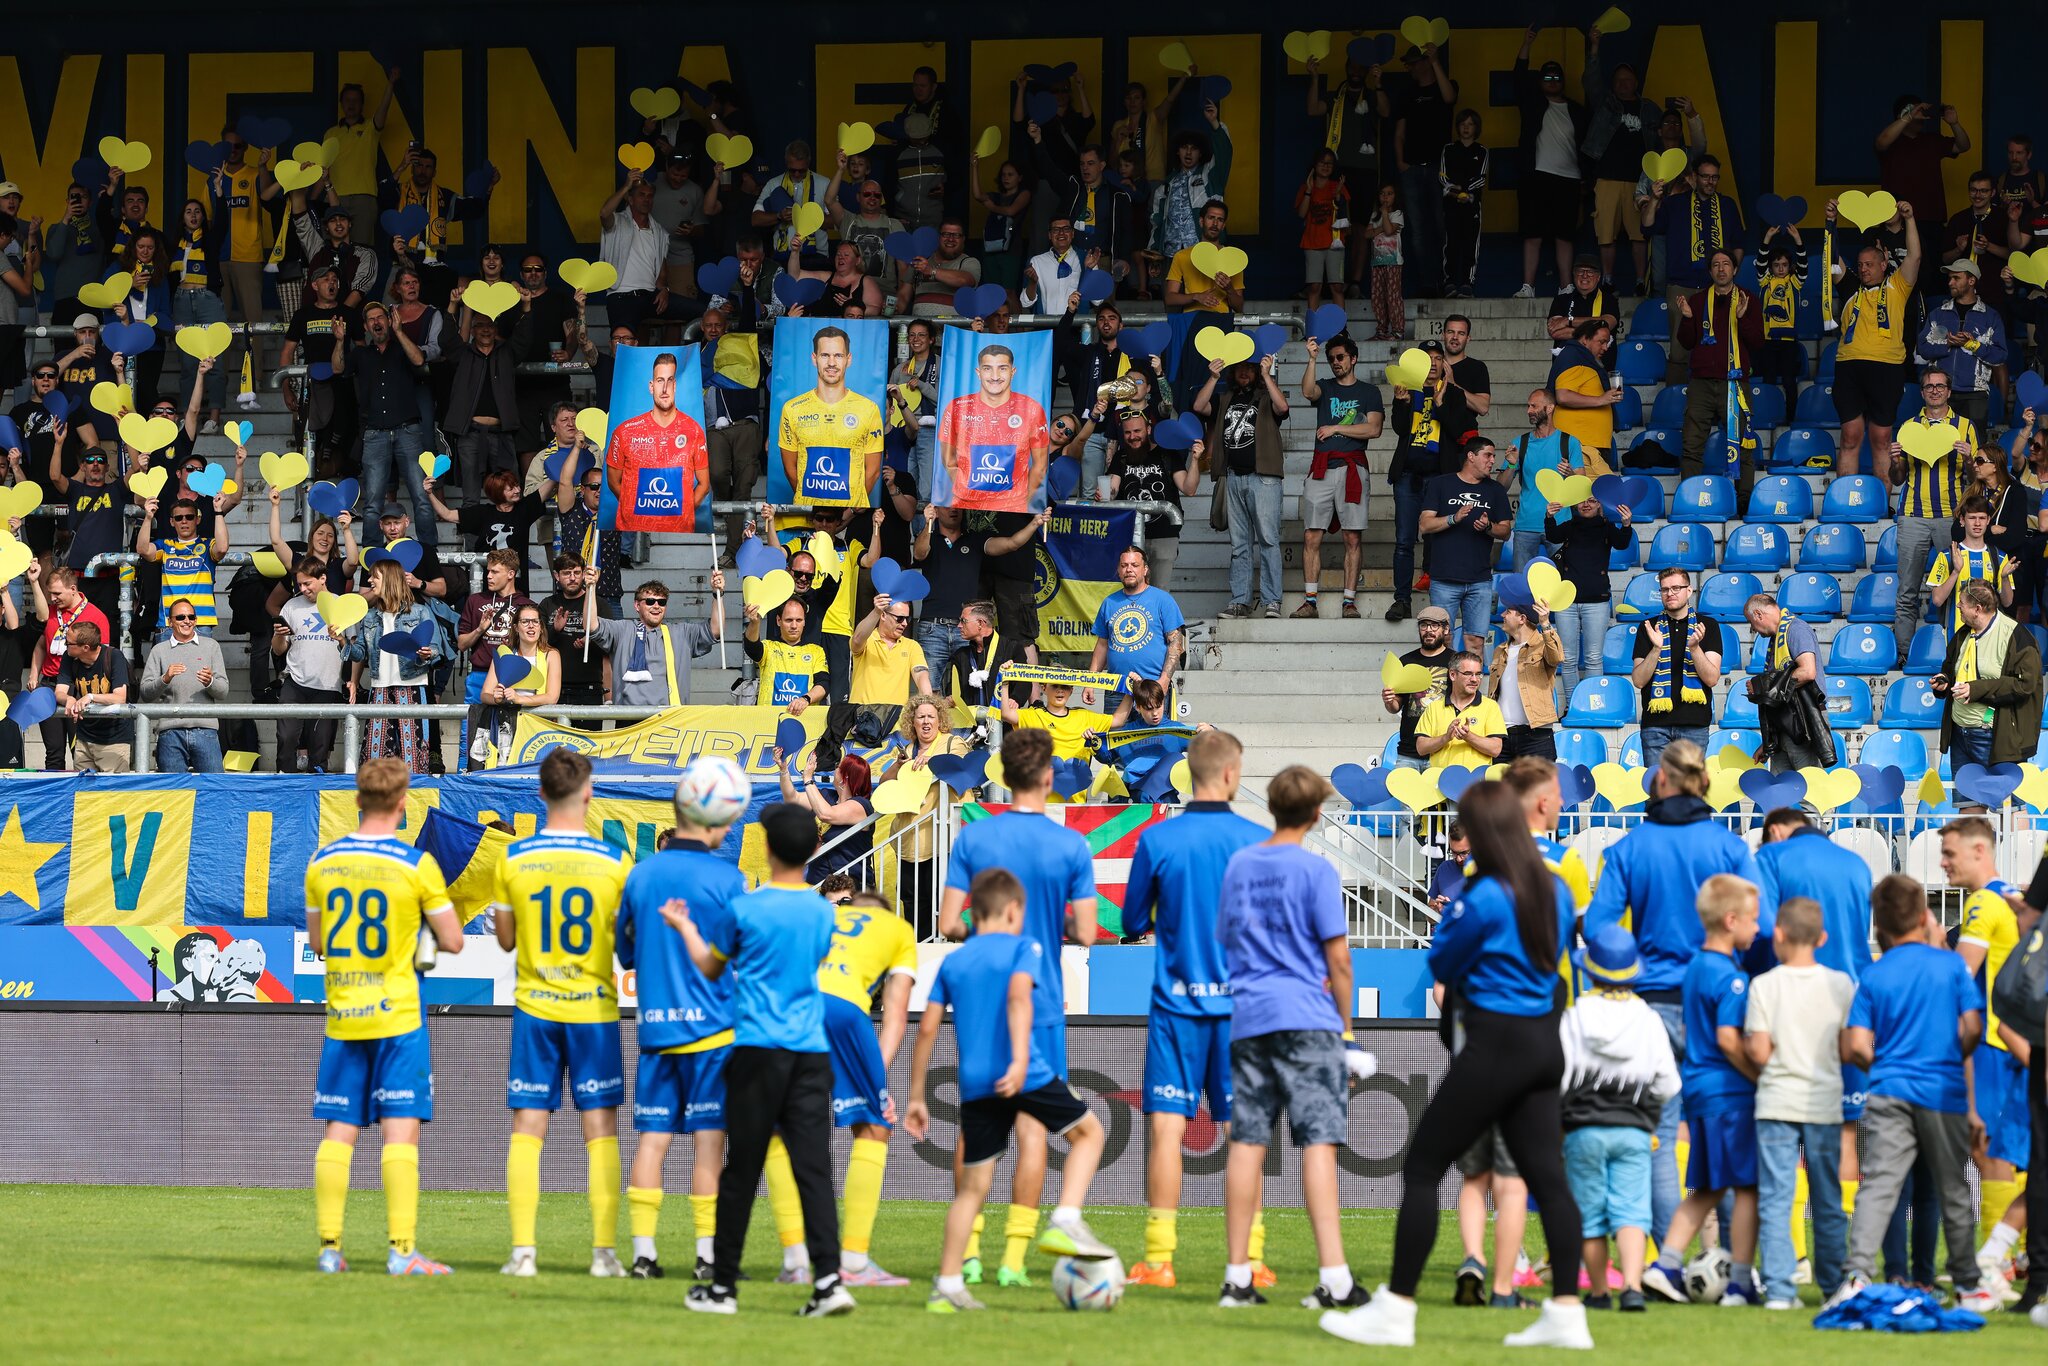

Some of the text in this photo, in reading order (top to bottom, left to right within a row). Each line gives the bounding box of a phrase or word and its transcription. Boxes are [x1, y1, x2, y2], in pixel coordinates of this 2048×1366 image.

[797, 413, 819, 422] IMMO
[962, 414, 983, 423] IMMO
[806, 478, 848, 491] UNIQA
[971, 473, 1010, 485] UNIQA
[637, 497, 679, 509] UNIQA
[168, 561, 200, 570] PayLife
[1018, 670, 1044, 680] Vienna
[1045, 672, 1097, 684] Football-Club
[1097, 677, 1115, 686] 1894
[774, 693, 800, 702] UNIQ
[1181, 704, 1187, 713] 5
[527, 734, 591, 756] VIENNA FOOTB
[1370, 758, 1378, 767] 4
[326, 887, 388, 959] 28
[530, 885, 594, 955] 18
[645, 1009, 665, 1023] GR
